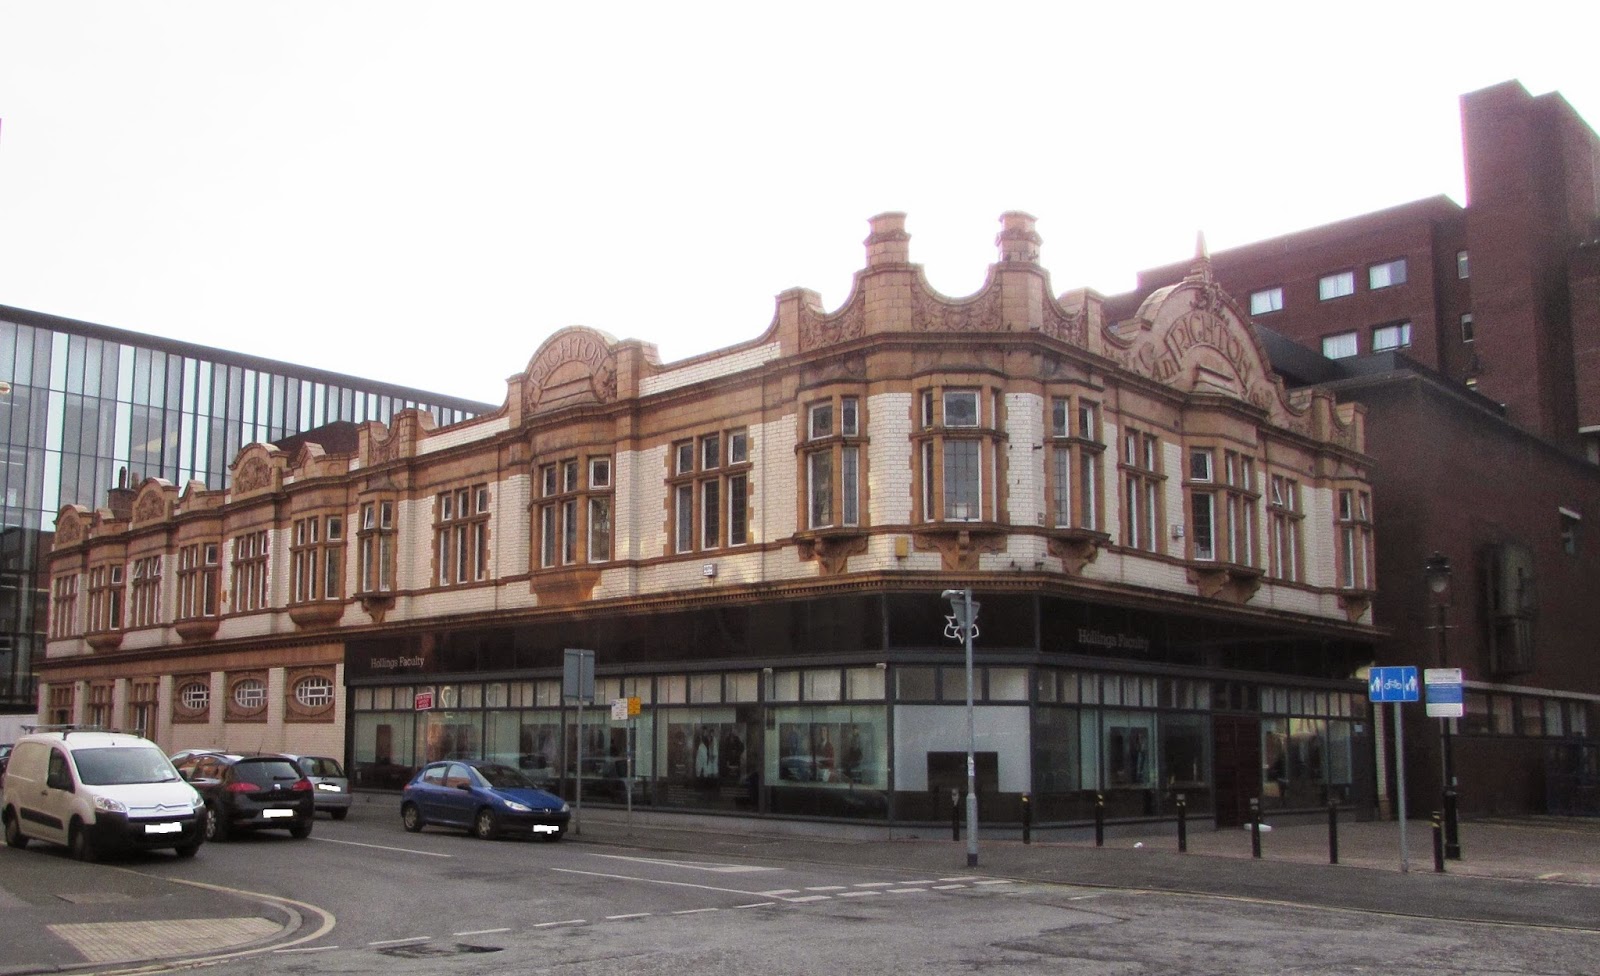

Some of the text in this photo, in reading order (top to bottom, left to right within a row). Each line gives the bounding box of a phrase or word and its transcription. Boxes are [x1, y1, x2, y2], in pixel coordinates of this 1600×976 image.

[1078, 629, 1117, 648] Hollings
[370, 655, 425, 669] Hollings Faculty
